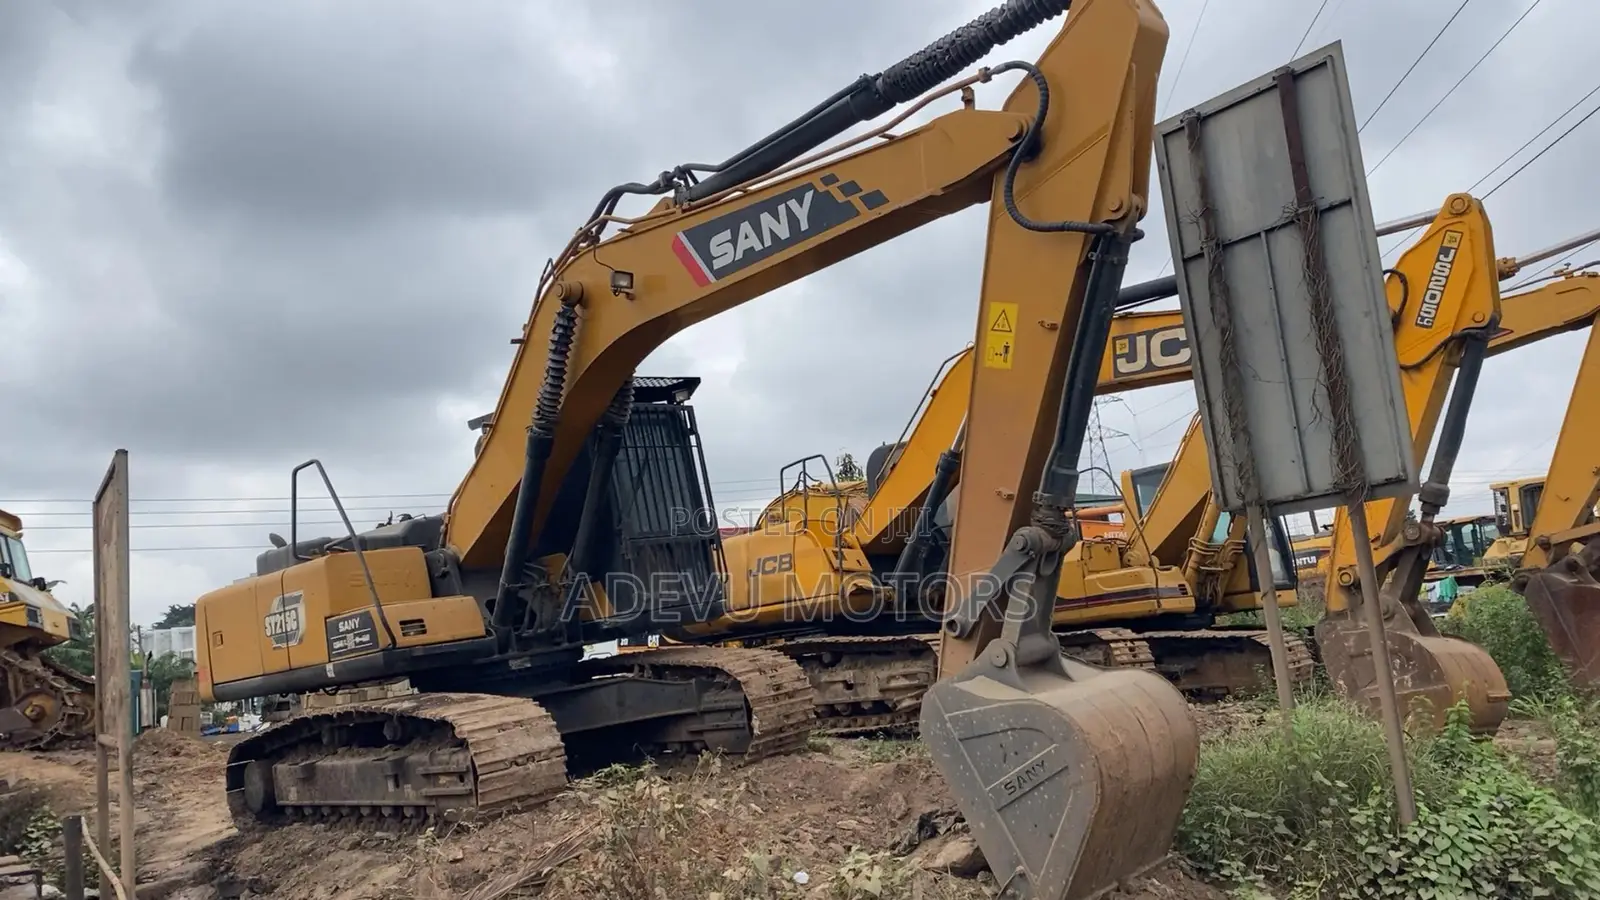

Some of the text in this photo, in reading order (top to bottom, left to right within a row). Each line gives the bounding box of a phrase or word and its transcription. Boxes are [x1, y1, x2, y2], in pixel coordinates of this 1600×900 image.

[709, 189, 814, 270] SANY
[1116, 327, 1192, 373] JC
[748, 553, 793, 577] JCB
[338, 617, 360, 632] SANY
[1004, 760, 1046, 795] SANY
